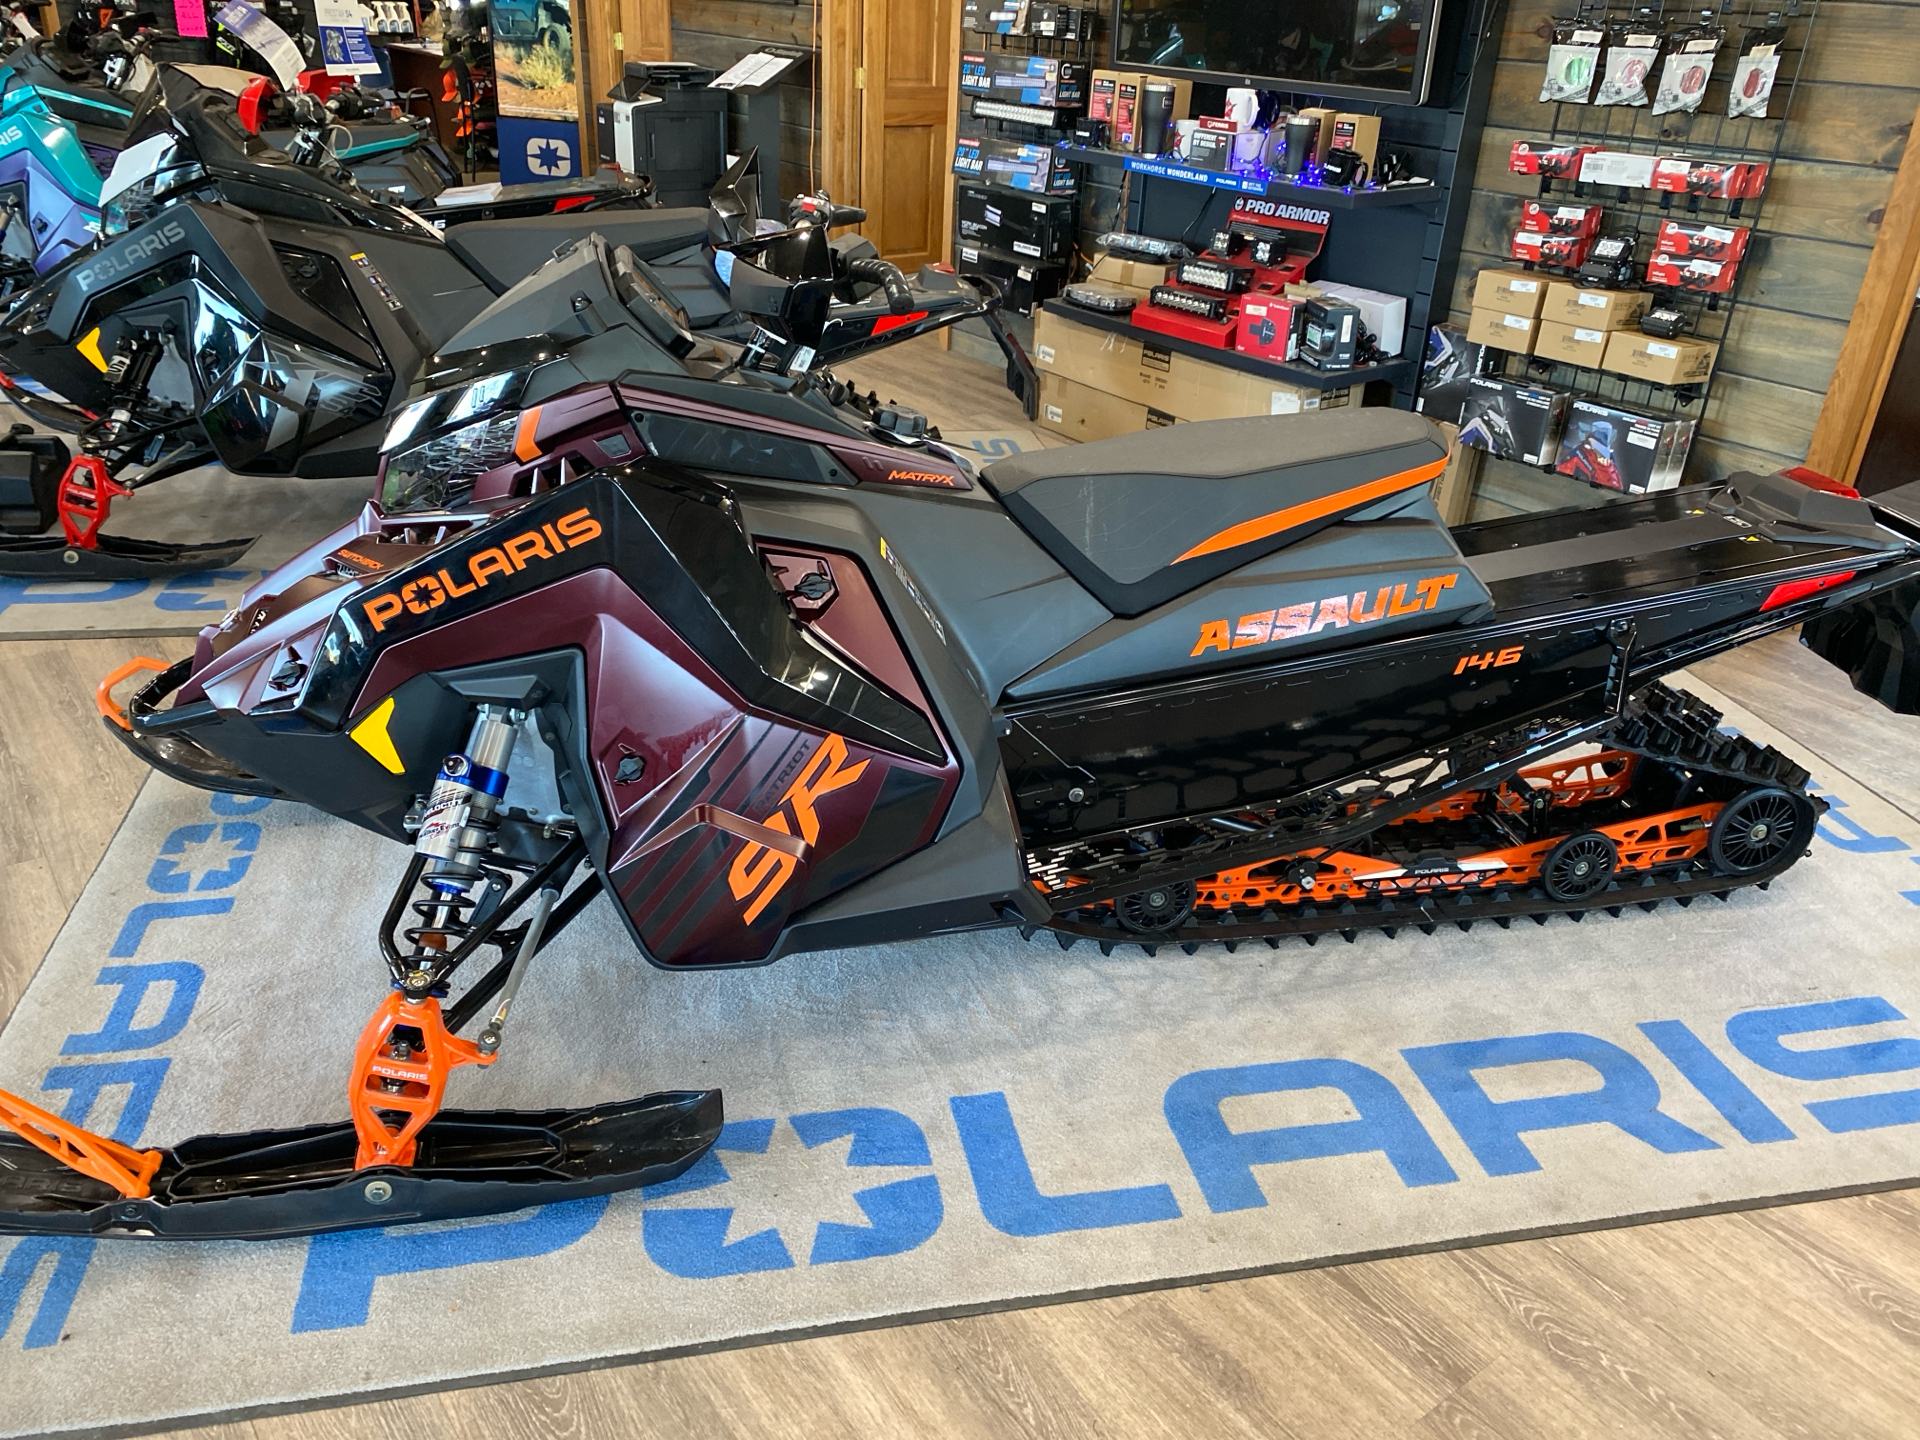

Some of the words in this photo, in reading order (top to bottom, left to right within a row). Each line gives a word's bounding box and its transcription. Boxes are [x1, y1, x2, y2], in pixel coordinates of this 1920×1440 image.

[962, 74, 978, 87] LIGHT
[978, 76, 991, 89] BAR
[954, 157, 970, 170] LIGHT
[970, 159, 984, 171] BAR
[1131, 161, 1166, 174] WORKHORSE
[1167, 168, 1208, 182] WONDERLAND
[1244, 199, 1275, 216] PRO
[1274, 204, 1331, 225] ARMOR
[76, 221, 186, 292] POLARIS
[1143, 349, 1170, 362] POLARIS
[1470, 377, 1502, 391] POLARIS
[1573, 402, 1608, 417] POLARIS
[888, 469, 955, 487] MATRYX
[337, 548, 384, 570] SWITCHBACK
[362, 507, 602, 633] POLARIS
[1189, 572, 1459, 657] ASSAULT
[1453, 644, 1525, 676] 146
[753, 739, 811, 813] PATRIOT
[1414, 867, 1450, 875] POLARIS
[372, 1065, 428, 1081] POLARIS
